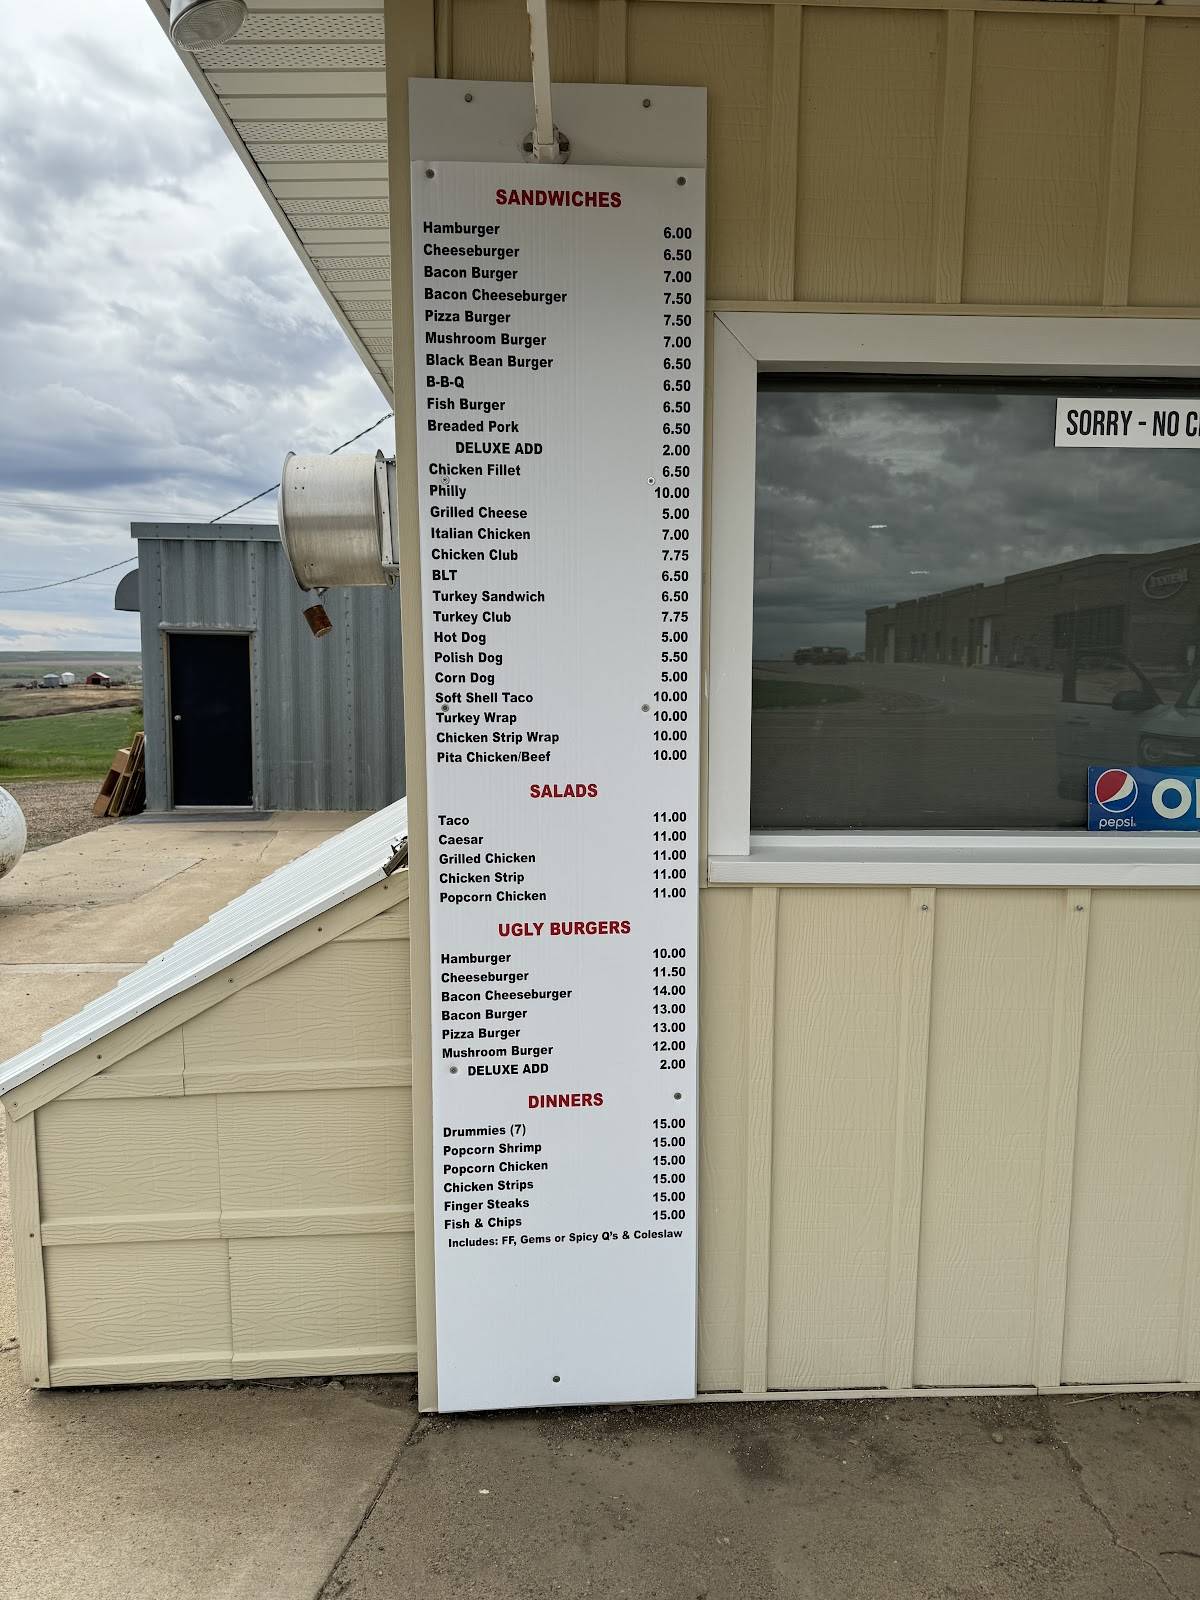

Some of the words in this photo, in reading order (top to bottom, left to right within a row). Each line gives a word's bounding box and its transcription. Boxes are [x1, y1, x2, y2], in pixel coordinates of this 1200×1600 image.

[496, 189, 621, 207] SANDWICHES
[424, 221, 500, 237] Hamburger
[664, 227, 692, 239] 6.00
[424, 244, 520, 260] Cheeseburger
[664, 249, 691, 261] 6.50
[424, 266, 466, 278] Bacon
[472, 267, 518, 282] Burger
[664, 271, 691, 283] 7.00
[425, 288, 467, 300] Bacon
[472, 288, 567, 305] Cheeseburger
[664, 293, 691, 304] 7.50
[425, 310, 460, 322] Pizza
[465, 310, 511, 326] Burger
[664, 314, 691, 326] 7.50
[426, 332, 496, 344] Mushroom
[501, 333, 546, 348] Burger
[664, 336, 691, 348] 7.00
[426, 354, 464, 366] Black
[469, 354, 503, 366] Bean
[508, 355, 553, 370] Burger
[664, 358, 691, 370] 6.50
[427, 376, 464, 388] B-B-Q
[663, 380, 691, 391] 6.50
[427, 398, 455, 409] Fish
[460, 398, 505, 413] Burger
[663, 401, 690, 413] 6.50
[428, 420, 483, 432] Breaded
[489, 421, 519, 432] Pork
[663, 423, 690, 434] 6.50
[1067, 410, 1132, 435] SORRY
[1153, 411, 1179, 436] NO
[1186, 412, 1200, 436] C
[456, 442, 510, 454] DELUXE
[515, 443, 542, 454] ADD
[663, 445, 690, 456] 2.00
[429, 463, 482, 475] Chicken
[488, 464, 520, 476] Fillet
[663, 466, 690, 477] 6.50
[430, 485, 466, 499] Philly
[654, 487, 689, 498] 10.00
[430, 506, 473, 518] Grilled
[479, 507, 527, 518] Cheese
[663, 508, 689, 519] 5.00
[431, 527, 473, 539] Italian
[478, 528, 530, 539] Chicken
[662, 529, 689, 540] 7.00
[432, 549, 484, 560] Chicken
[489, 549, 518, 560] Club
[662, 550, 688, 561] 7.75
[432, 570, 457, 580] BLT
[662, 571, 688, 581] 6.50
[432, 590, 477, 604] Turkey
[482, 591, 544, 602] Sandwich
[662, 591, 688, 602] 6.50
[433, 611, 478, 625] Turkey
[483, 611, 511, 622] Club
[662, 611, 688, 622] 7.75
[434, 632, 457, 642] Hot
[462, 632, 486, 645] Dog
[662, 632, 688, 642] 5.00
[435, 652, 473, 662] Polish
[479, 652, 502, 665] Dog
[662, 652, 687, 662] 5.50
[435, 672, 465, 683] Corn
[471, 672, 494, 685] Dog
[661, 672, 687, 682] 5.00
[436, 692, 461, 704] Soft
[466, 692, 497, 703] Shell
[502, 692, 533, 702] Taco
[654, 691, 687, 702] 10.00
[436, 712, 480, 725] Turkey
[484, 712, 517, 725] Wrap
[654, 711, 687, 721] 10.00
[437, 732, 488, 743] Chicken
[493, 732, 523, 745] Strip
[527, 732, 559, 744] Wrap
[654, 731, 687, 741] 10.00
[437, 752, 462, 762] Pita
[467, 751, 550, 762] Chicken/Beef
[654, 750, 687, 760] 10.00
[530, 784, 597, 798] SALADS
[1152, 778, 1200, 819] O
[438, 815, 469, 825] Taco
[654, 812, 686, 822] 11.00
[1099, 817, 1133, 829] pepsi
[439, 835, 483, 845] Caesar
[654, 831, 686, 841] 11.00
[439, 854, 480, 864] Grilled
[485, 853, 535, 863] Chicken
[653, 850, 686, 860] 11.00
[440, 873, 490, 883] Chicken
[495, 872, 524, 884] Strip
[653, 869, 686, 879] 11.00
[440, 893, 492, 904] Popcorn
[497, 891, 546, 901] Chicken
[653, 888, 686, 898] 11.00
[499, 923, 544, 936] UGLY
[550, 921, 630, 935] BURGERS
[441, 953, 511, 965] Hamburger
[653, 948, 686, 958] 10.00
[441, 972, 529, 985] Cheeseburger
[653, 967, 685, 977] 11.50
[442, 992, 480, 1002] Bacon
[485, 989, 572, 1001] Cheeseburger
[653, 985, 685, 995] 14.00
[442, 1011, 480, 1020] Bacon
[486, 1009, 527, 1021] Burger
[653, 1004, 685, 1014] 13.00
[442, 1029, 474, 1039] Pizza
[479, 1028, 520, 1040] Burger
[653, 1022, 685, 1032] 13.00
[443, 1048, 506, 1058] Mushroom
[512, 1046, 553, 1057] Burger
[653, 1041, 685, 1051] 12.00
[468, 1064, 518, 1076] DELUXE
[523, 1064, 548, 1074] ADD
[660, 1059, 685, 1069] 2.00
[529, 1093, 603, 1108] DINNERS
[444, 1125, 506, 1137] Drummies
[510, 1124, 526, 1137] (7)
[653, 1119, 685, 1129] 15.00
[444, 1144, 494, 1157] Popcorn
[499, 1143, 541, 1154] Shrimp
[653, 1137, 685, 1147] 15.00
[444, 1163, 494, 1176] Popcorn
[499, 1161, 548, 1172] Chicken
[653, 1155, 685, 1165] 15.00
[444, 1182, 493, 1192] Chicken
[498, 1180, 533, 1192] Strips
[653, 1173, 685, 1184] 15.00
[444, 1201, 483, 1213] Finger
[487, 1198, 529, 1209] Steaks
[653, 1192, 685, 1202] 15.00
[445, 1219, 469, 1229] Fish
[475, 1218, 483, 1228] &
[488, 1217, 522, 1229] Chips
[653, 1210, 685, 1220] 15.00
[449, 1238, 498, 1247] Includes:
[502, 1236, 516, 1246] FF,
[521, 1235, 551, 1244] Gems
[569, 1233, 598, 1243] Spicy
[602, 1231, 618, 1242] Q's
[622, 1231, 630, 1239] &
[634, 1229, 683, 1239] Coleslaw
